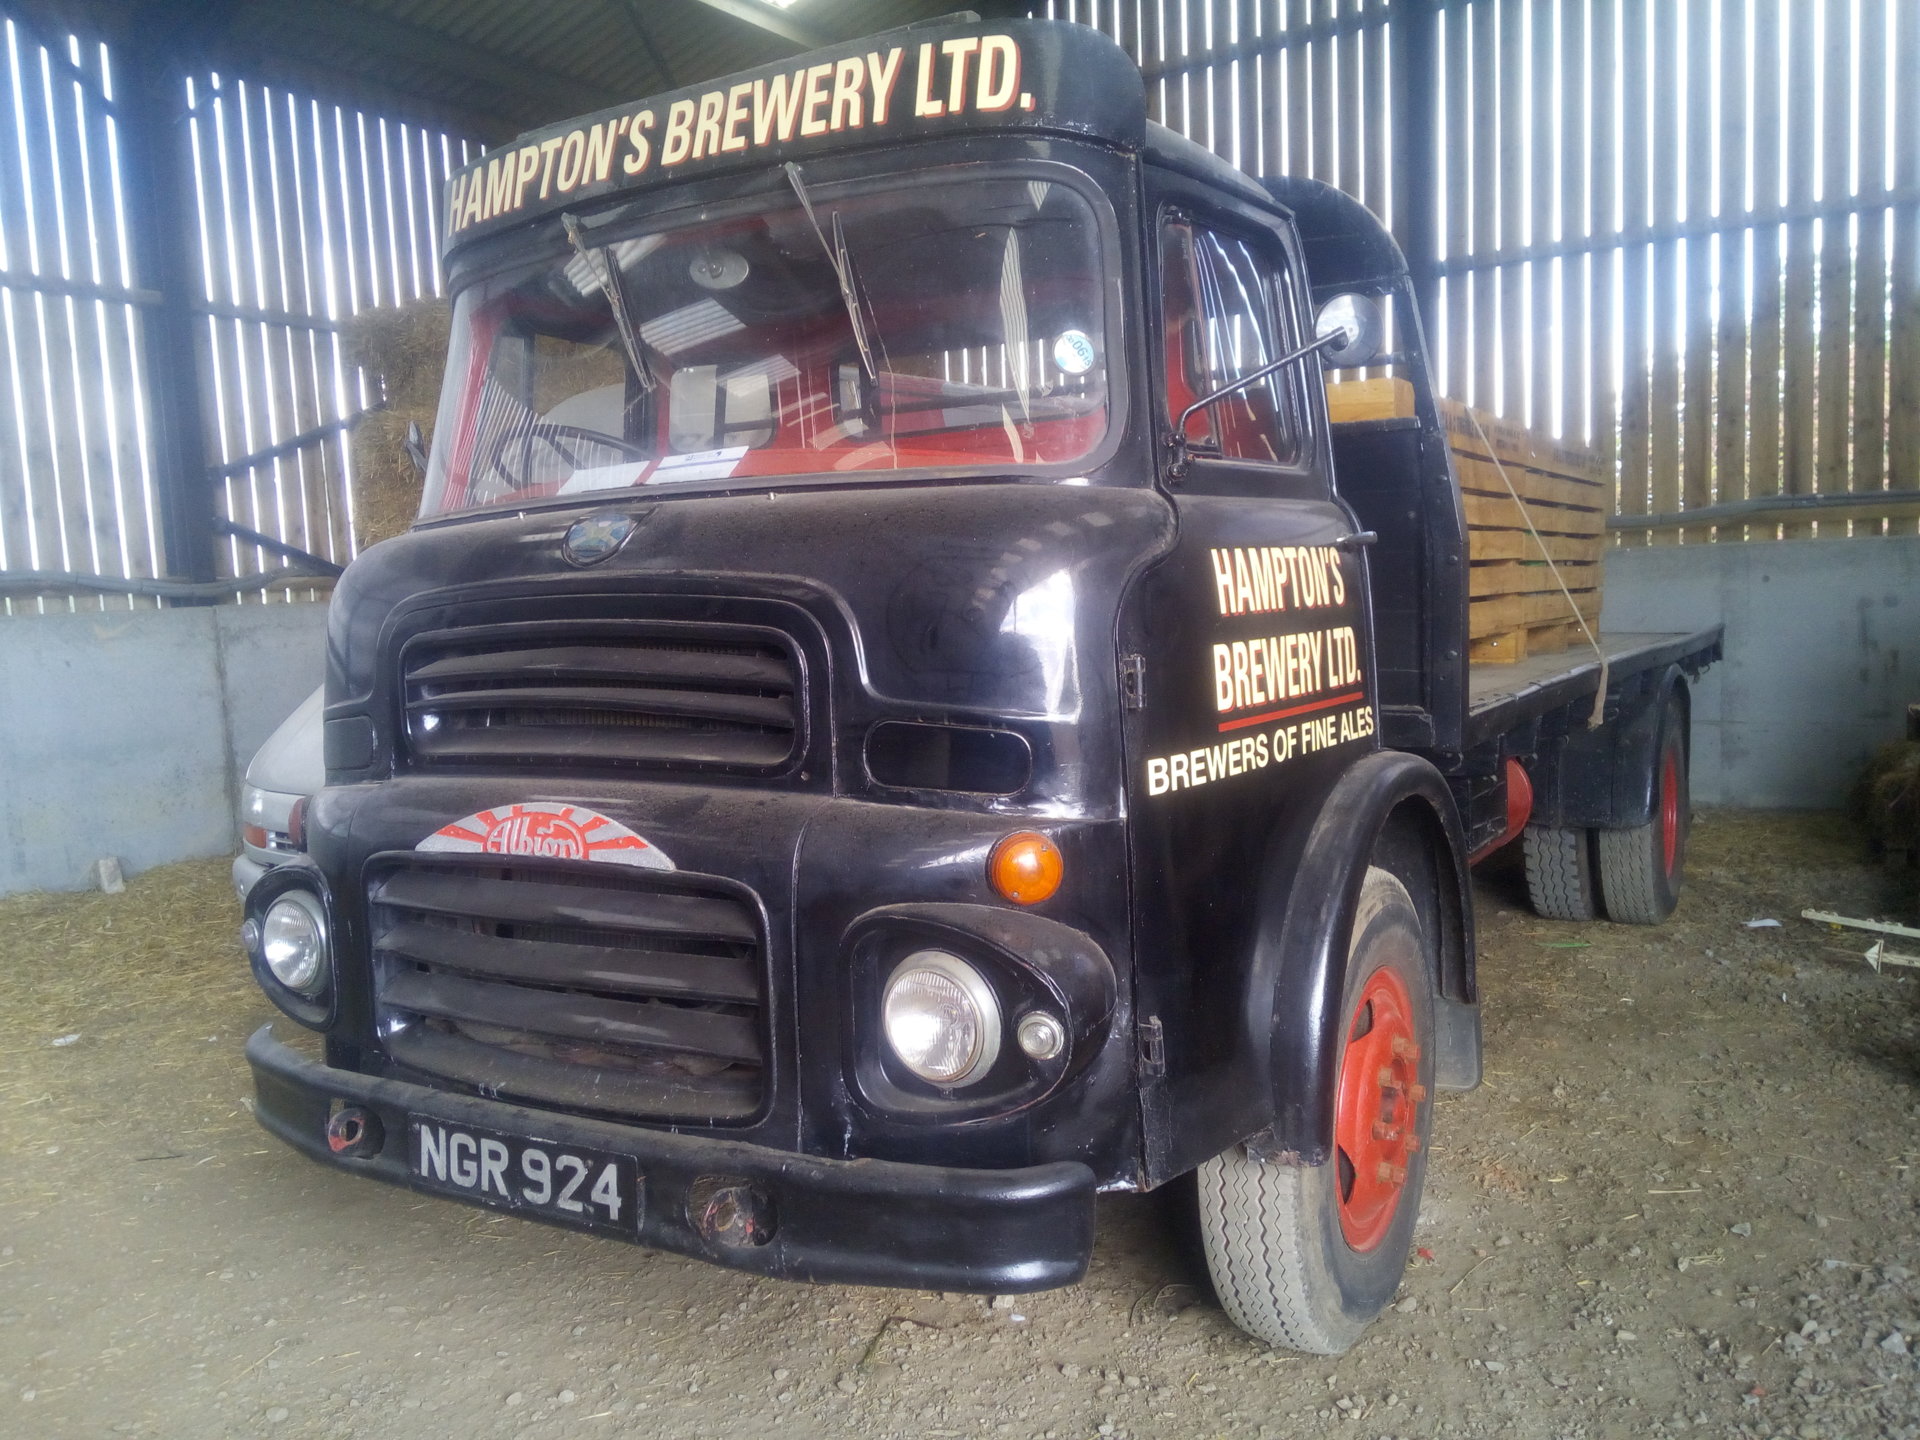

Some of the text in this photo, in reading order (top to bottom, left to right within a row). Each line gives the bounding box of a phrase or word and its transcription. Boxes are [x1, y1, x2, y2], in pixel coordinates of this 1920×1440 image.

[447, 35, 1035, 237] HAMPTON'S BREWERY LTD.
[1211, 546, 1345, 616] HAMPTON'S
[1213, 626, 1362, 713] BREWERY LTD.
[1148, 706, 1374, 796] BREWERS OF FINE ALES
[487, 815, 583, 859] Albion
[420, 1125, 622, 1221] NGR 924
